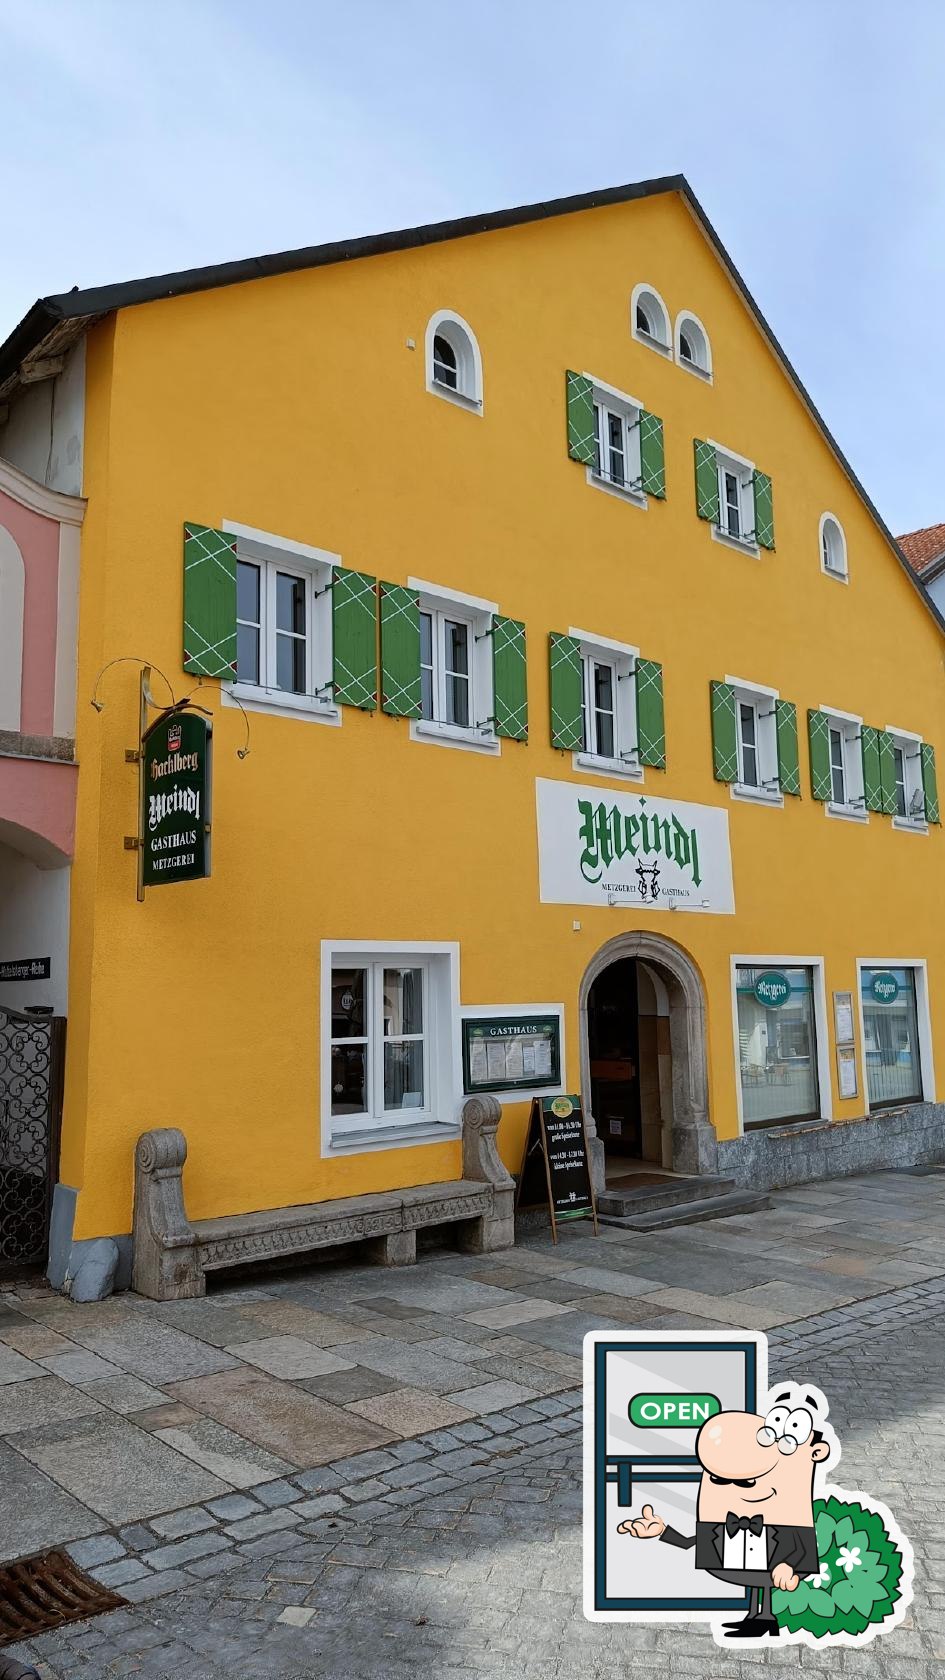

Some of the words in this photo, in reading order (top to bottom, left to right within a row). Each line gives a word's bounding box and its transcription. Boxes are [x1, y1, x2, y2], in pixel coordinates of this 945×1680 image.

[151, 751, 199, 782] Hacklberg
[149, 783, 201, 831] Meindl
[151, 830, 197, 852] GASTHAUS
[578, 796, 702, 888] Meindl
[152, 853, 195, 870] METZGEREI
[602, 883, 636, 893] METZGEREI
[662, 888, 690, 897] GASTHAUS
[757, 980, 786, 1001] Metzgerei
[490, 1025, 537, 1036] GASTHAUS
